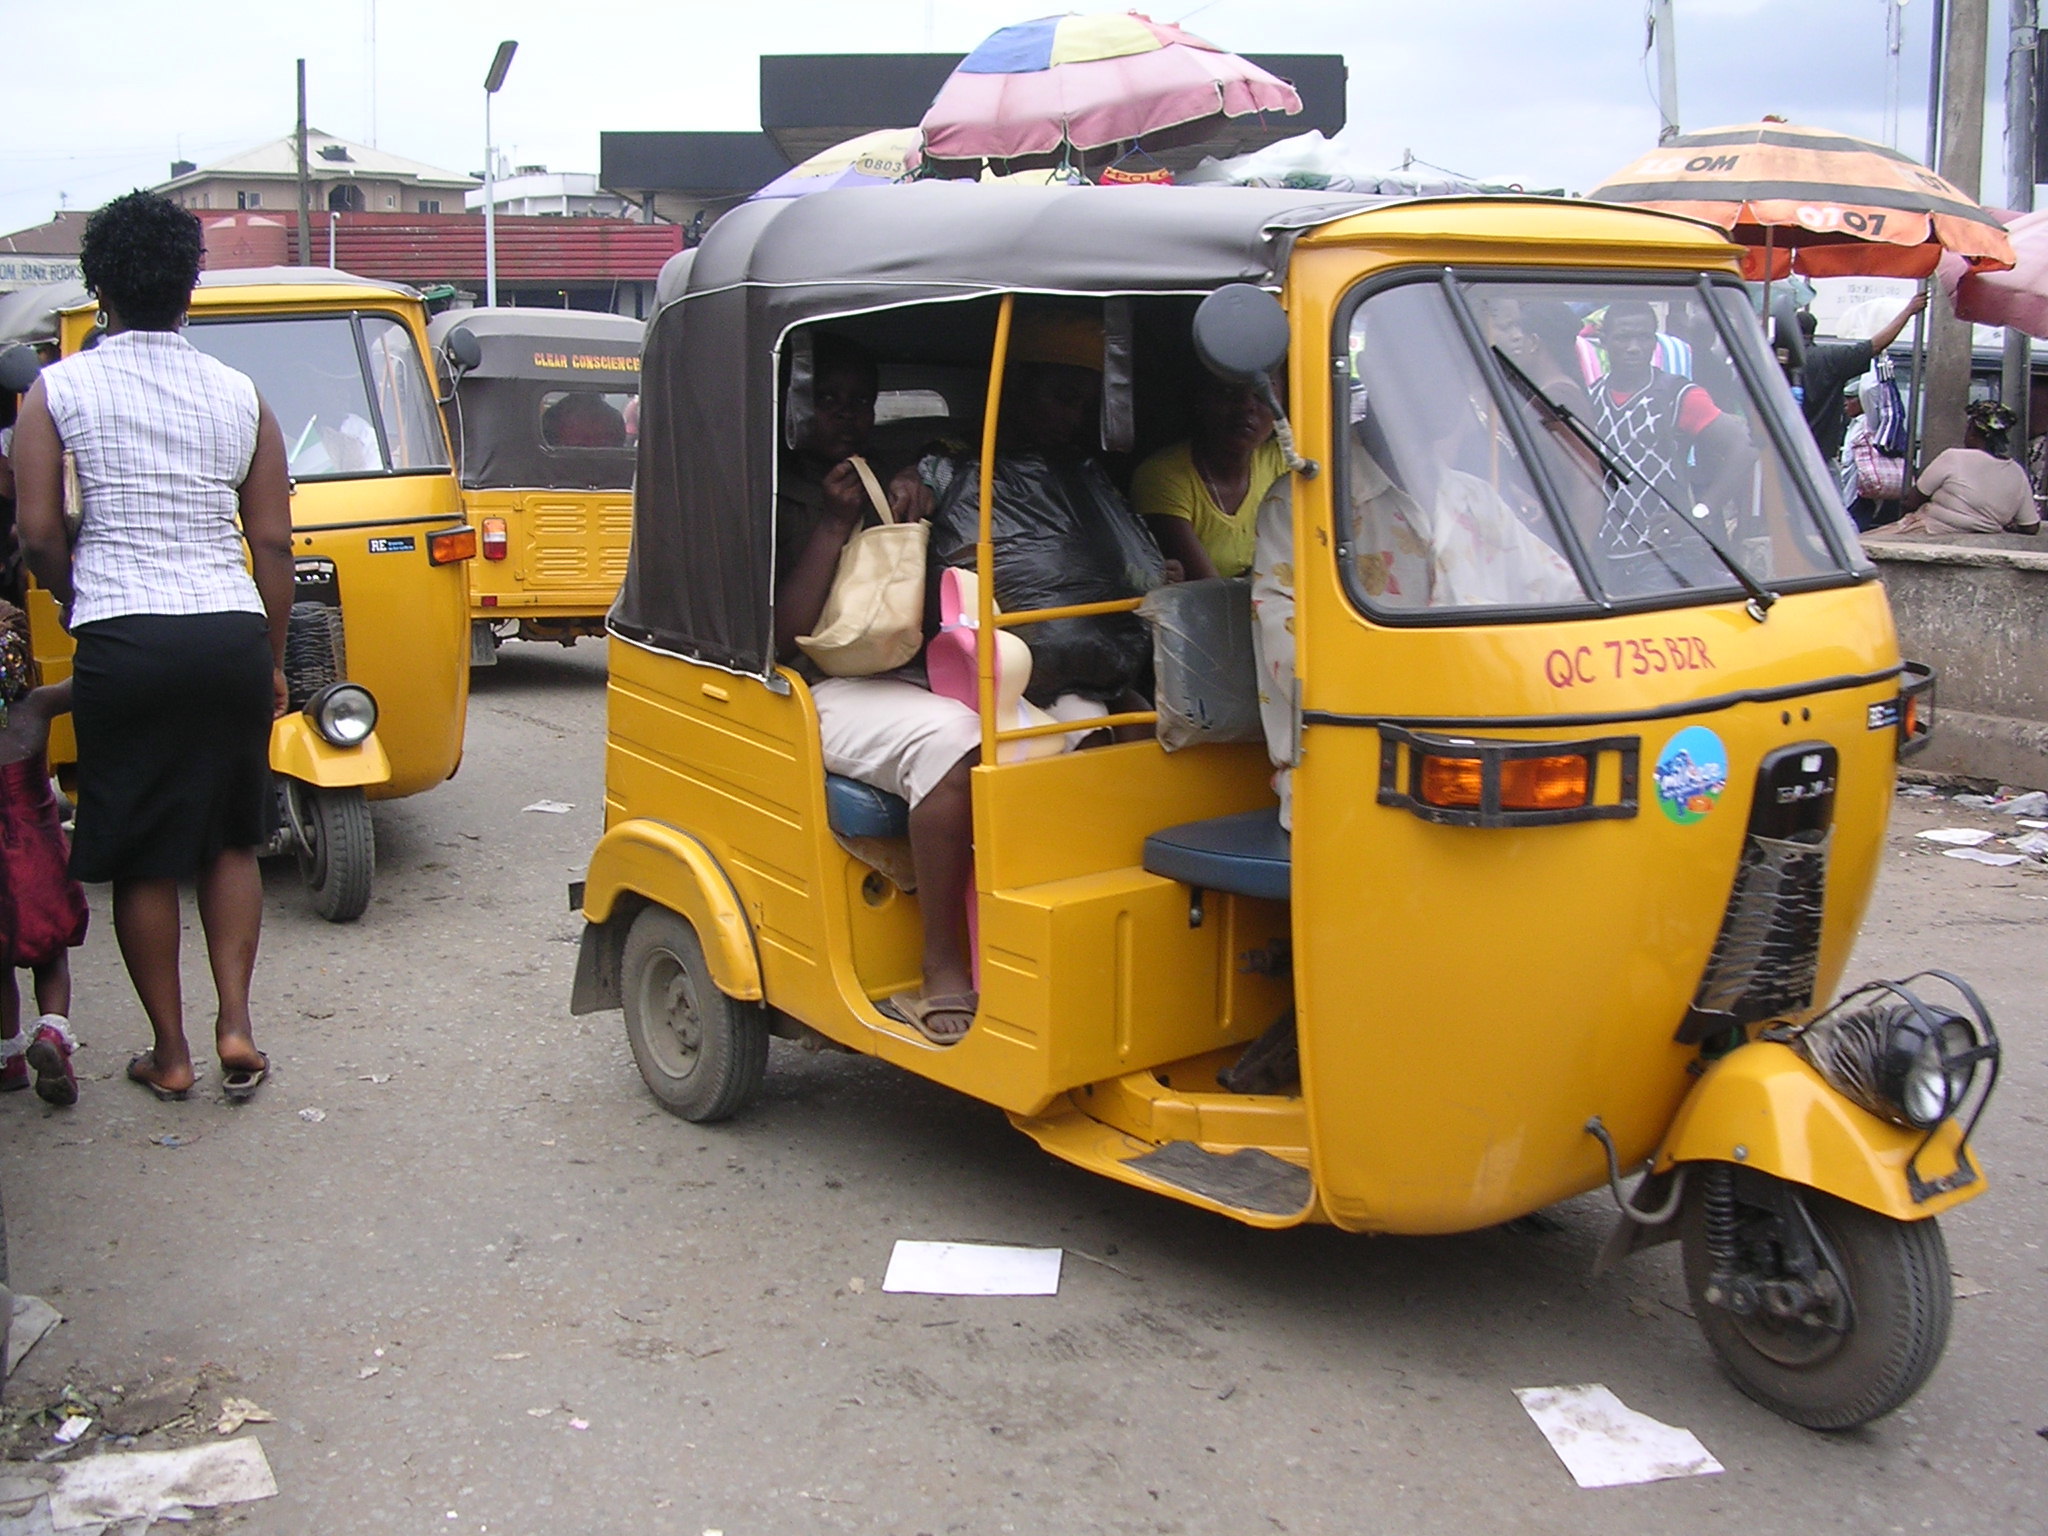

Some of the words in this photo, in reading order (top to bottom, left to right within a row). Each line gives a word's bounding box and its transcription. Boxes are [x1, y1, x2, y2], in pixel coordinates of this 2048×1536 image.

[864, 158, 902, 173] 0803
[1795, 206, 1887, 236] 0707
[534, 352, 568, 369] CLEAR
[572, 354, 641, 372] CONSCIENCE
[1546, 646, 1596, 688] QC
